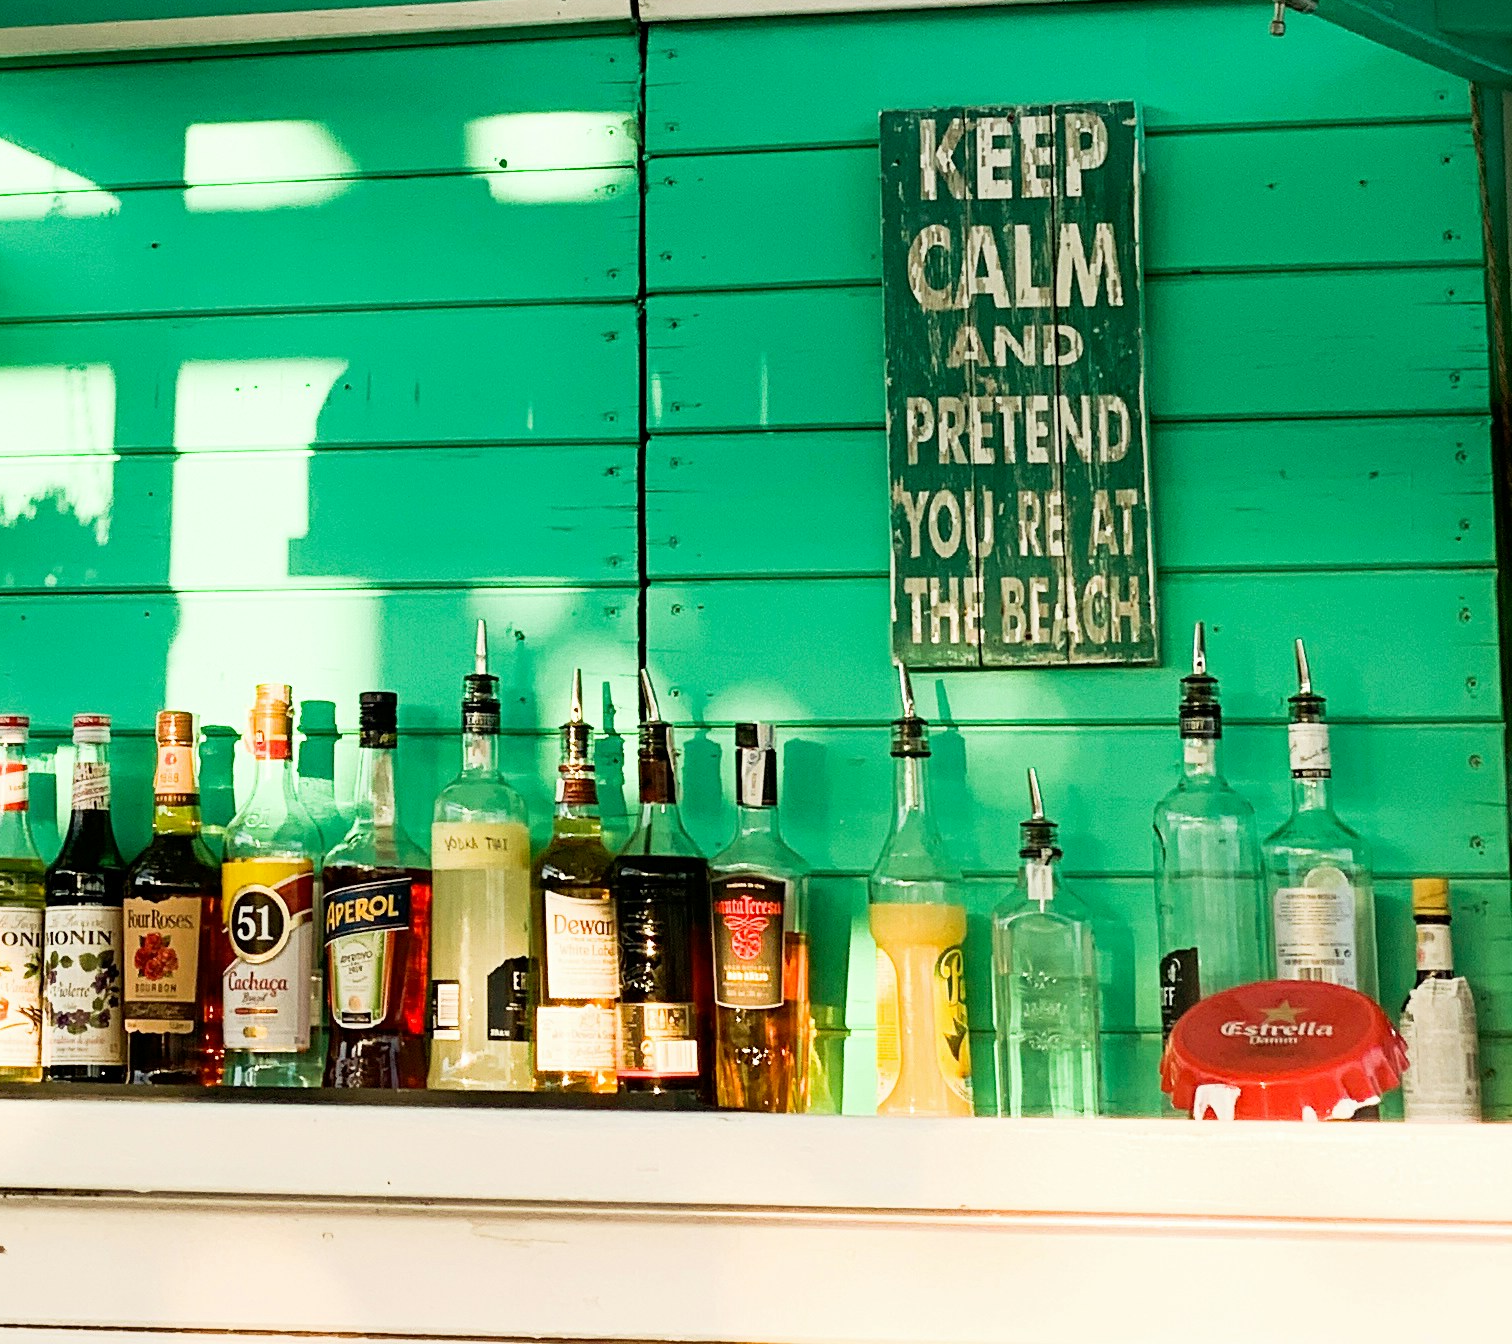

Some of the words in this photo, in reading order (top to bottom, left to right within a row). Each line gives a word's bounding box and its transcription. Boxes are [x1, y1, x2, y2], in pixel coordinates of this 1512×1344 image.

[919, 112, 1109, 201] KEEP
[907, 223, 1124, 311] CALM
[947, 325, 1084, 368] AND
[905, 394, 1132, 466] PRETEND
[1090, 488, 1139, 557] AT
[904, 576, 985, 646] THE
[1001, 575, 1141, 646] BEACH
[444, 835, 479, 852] VODKA
[128, 909, 151, 929] Four
[237, 904, 275, 942] 51
[326, 894, 400, 934] APEROL
[553, 914, 615, 936] Dewar
[135, 983, 178, 993] BOURBON
[228, 970, 290, 998] Cachaça
[1220, 1020, 1334, 1038] Estrella
